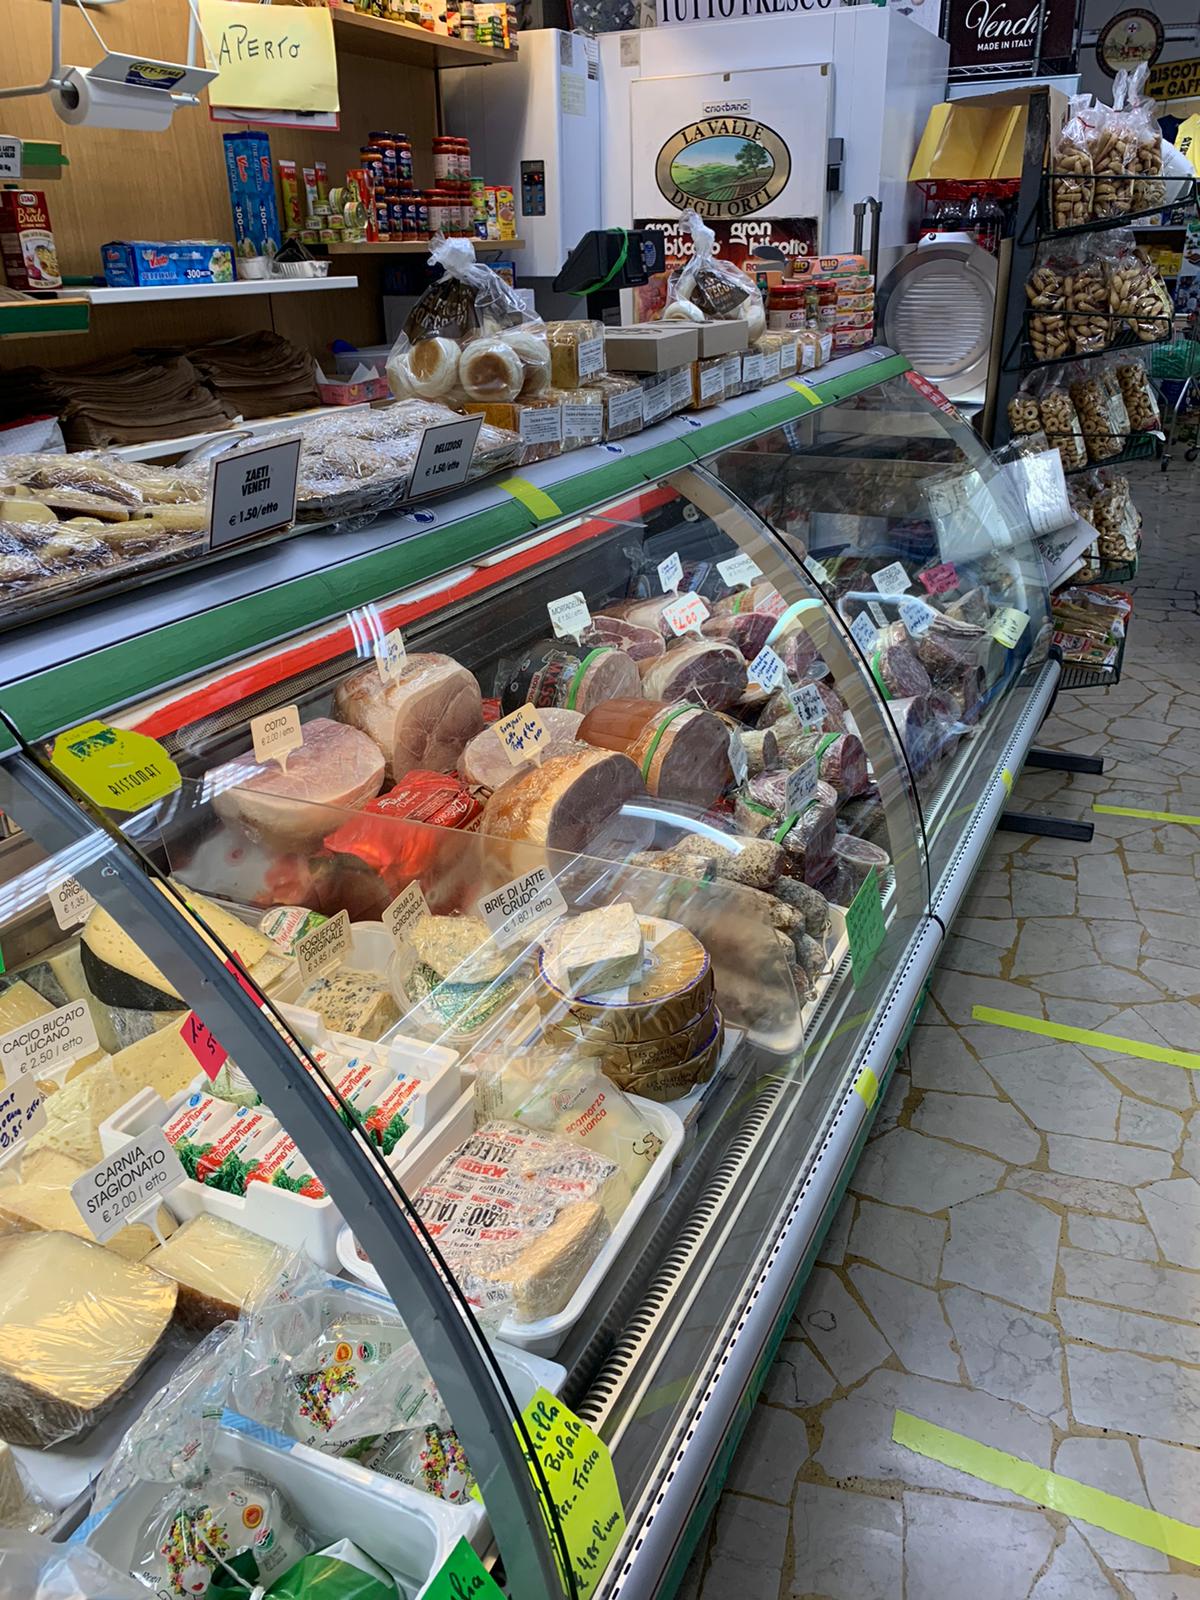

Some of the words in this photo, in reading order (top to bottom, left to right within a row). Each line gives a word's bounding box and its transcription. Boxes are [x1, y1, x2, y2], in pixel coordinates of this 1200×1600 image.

[965, 0, 1051, 38] Venchi
[219, 24, 301, 66] APERTO
[977, 42, 999, 51] MADE
[1001, 41, 1010, 50] IN
[1011, 38, 1034, 48] ITALY
[1149, 61, 1200, 83] BISCOT
[1167, 78, 1200, 95] CAFF
[680, 125, 706, 145] LA
[707, 119, 764, 141] VALLE
[16, 208, 46, 223] Brodo
[235, 206, 243, 225] 300
[259, 205, 267, 225] 300
[671, 189, 722, 217] DEGLI
[728, 188, 772, 216] ORTI
[729, 221, 772, 245] gran
[186, 269, 201, 278] 300
[241, 477, 271, 497] VENETI
[244, 464, 270, 483] ZAETI
[228, 515, 237, 526] €
[264, 715, 288, 733] COTTO
[58, 883, 80, 903] ORIG
[484, 893, 507, 914] BRIE
[507, 885, 519, 900] DI
[519, 869, 546, 893] LATTE
[501, 887, 539, 916] CRUDO
[535, 897, 553, 912] etto
[299, 915, 345, 955] ROQUEFORT
[304, 929, 344, 962] ORIGINALE
[3, 1029, 40, 1054] CACIO
[42, 1006, 85, 1036] BUCATO
[25, 1026, 70, 1057] LUCANO
[19, 1062, 27, 1073] €
[30, 1050, 53, 1070] 2.50
[62, 1034, 84, 1051] etto
[565, 1092, 606, 1134] scamorza
[579, 1108, 607, 1137] bianca
[94, 1146, 146, 1187] CARNIA
[87, 1150, 166, 1214] STAGIONATO
[102, 1210, 112, 1223] €
[112, 1191, 137, 1217] 2.00
[145, 1170, 167, 1191] etto
